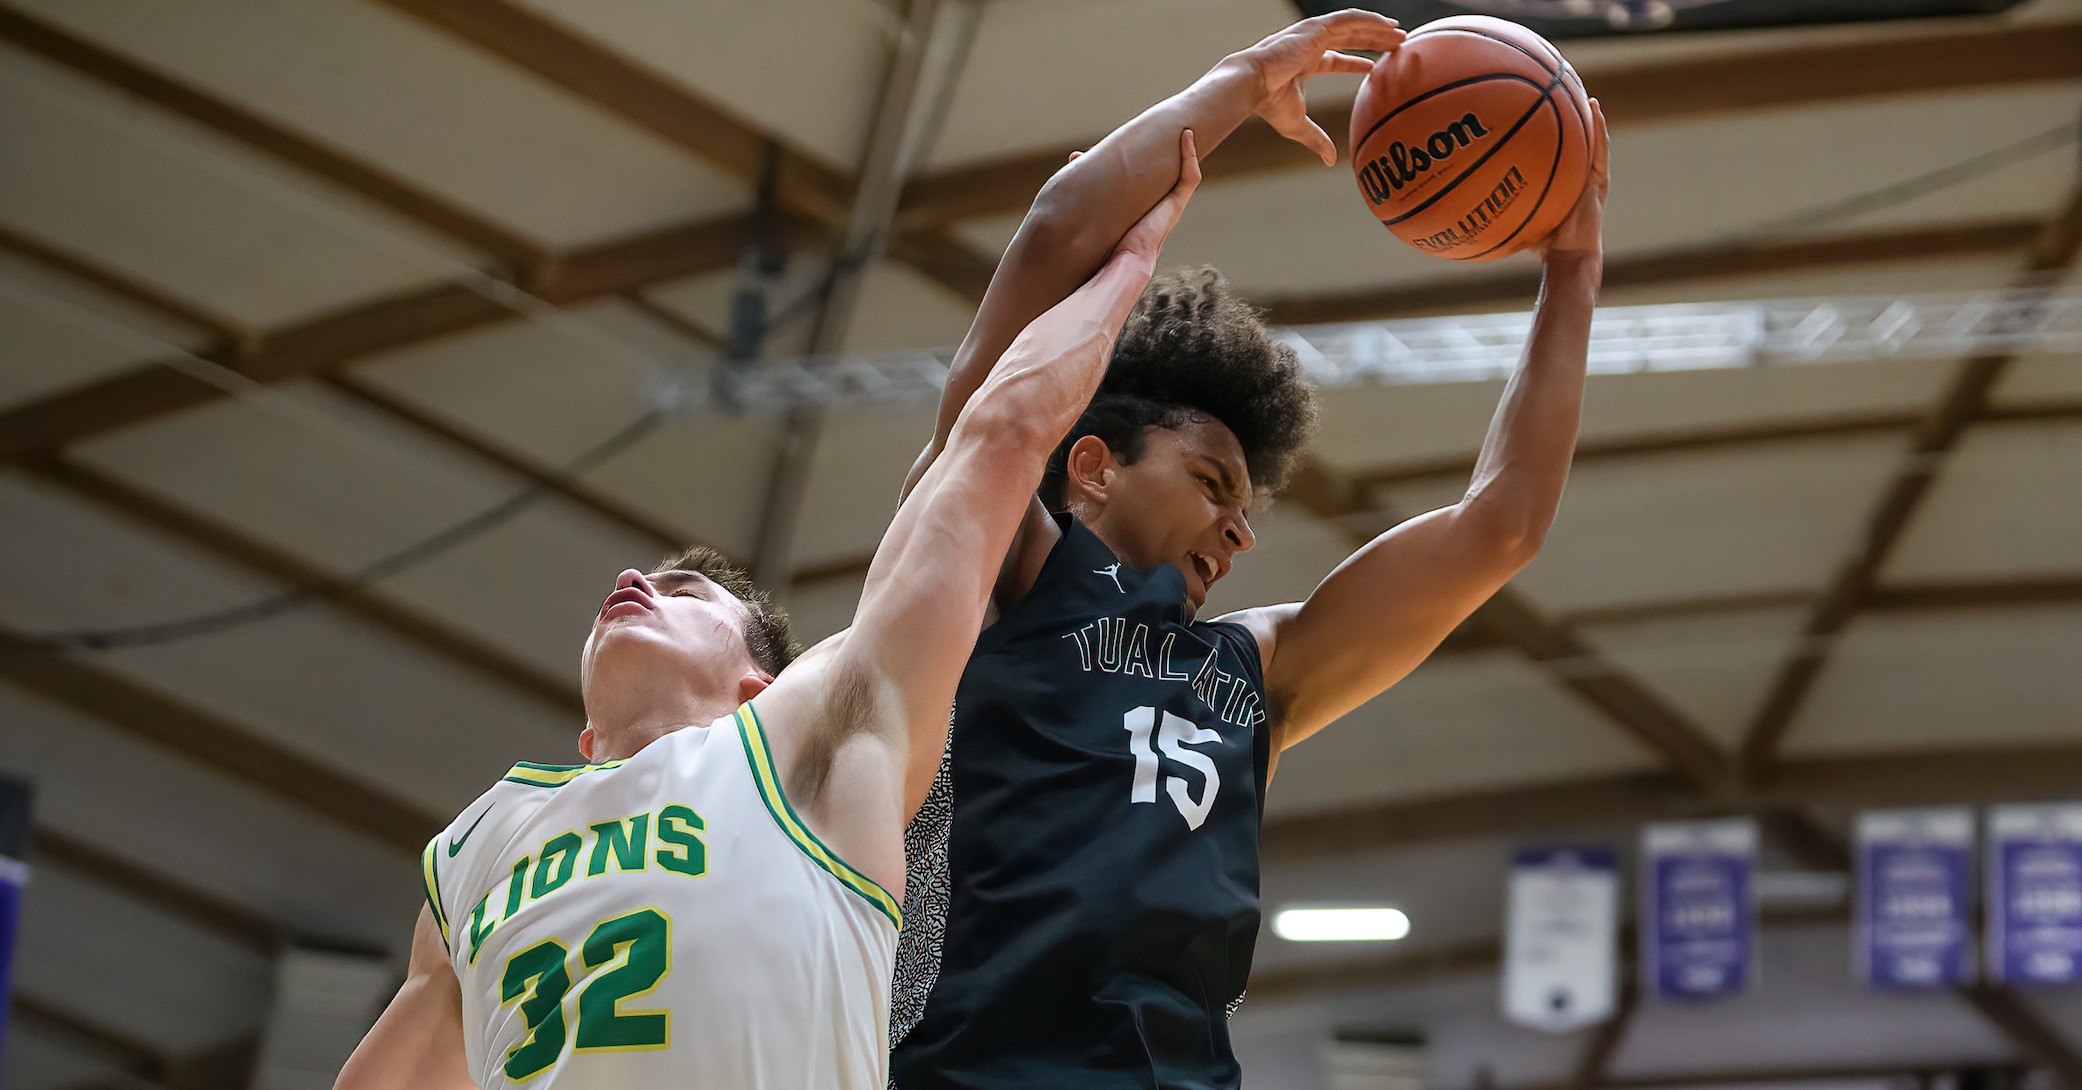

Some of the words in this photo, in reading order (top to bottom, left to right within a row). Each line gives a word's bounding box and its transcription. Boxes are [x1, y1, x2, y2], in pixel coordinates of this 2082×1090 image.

[1359, 112, 1488, 205] Wilson
[1412, 166, 1525, 249] EVOLUTION
[1123, 705, 1223, 832] 15
[468, 804, 709, 965] LIONS
[499, 906, 673, 1084] 32
